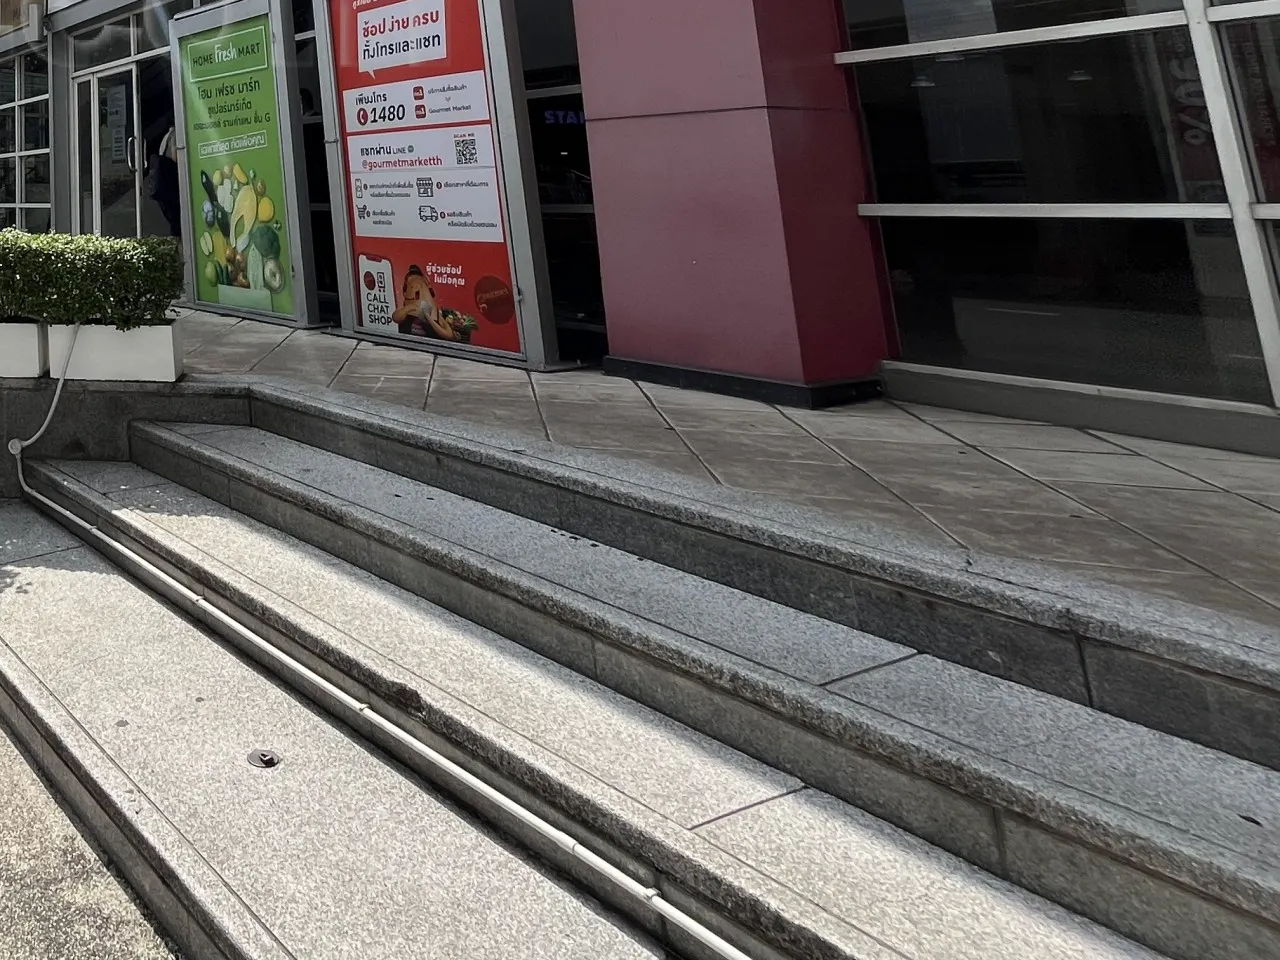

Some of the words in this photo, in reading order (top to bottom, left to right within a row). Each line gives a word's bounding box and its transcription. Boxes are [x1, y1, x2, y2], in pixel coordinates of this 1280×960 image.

[363, 18, 386, 38] ช้อป
[388, 15, 410, 33] ง่าย
[412, 10, 439, 28] ครบ
[363, 33, 441, 60] ทั้งโทรและแชท
[193, 54, 213, 67] HOME
[214, 42, 237, 63] Fresh
[238, 42, 260, 58] MART
[238, 77, 260, 93] มาร์ท
[355, 91, 387, 106] เพียงโทร
[265, 113, 271, 123] G
[370, 104, 406, 123] 1480
[393, 146, 406, 155] LINE
[362, 155, 443, 171] @gourmetmarketth
[367, 293, 389, 304] CALL
[367, 303, 389, 315] CHAT
[368, 314, 393, 326] SHOP
